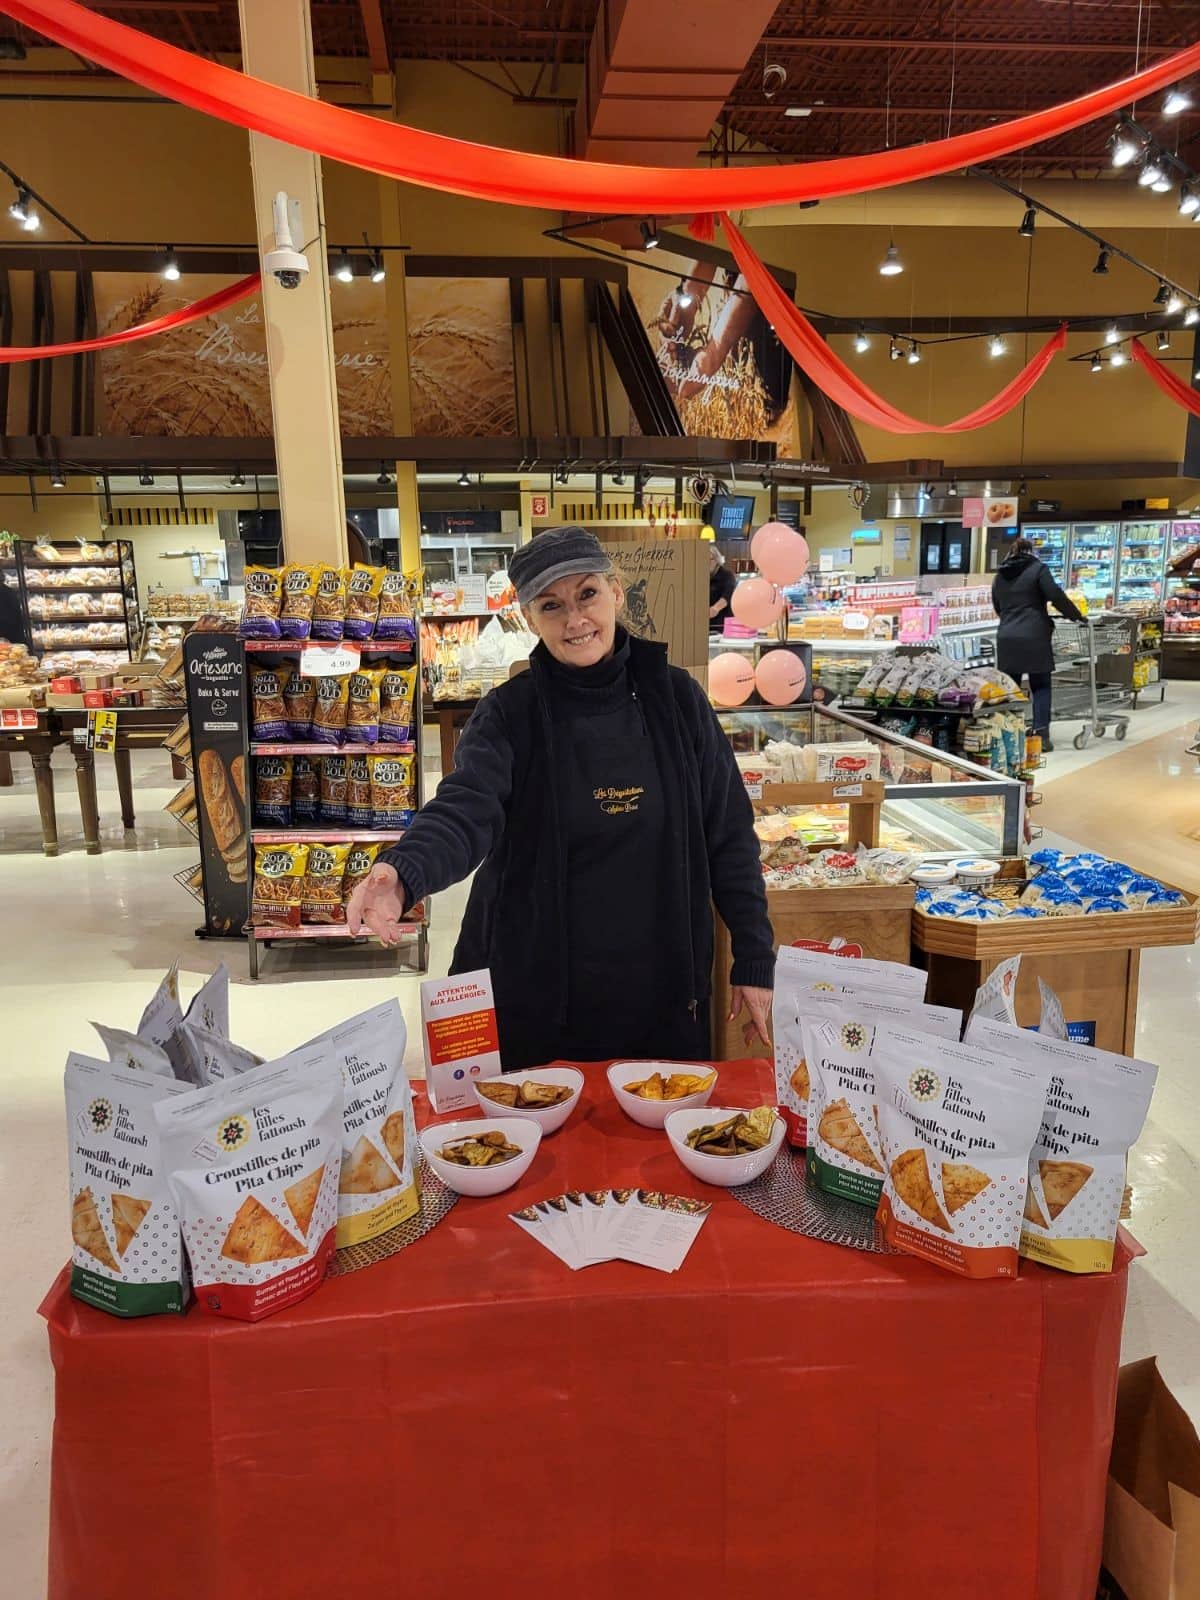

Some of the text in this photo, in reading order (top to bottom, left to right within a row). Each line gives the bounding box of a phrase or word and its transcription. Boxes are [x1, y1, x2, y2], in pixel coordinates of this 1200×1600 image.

[246, 583, 278, 592] GOLD
[287, 580, 310, 591] OLD
[350, 581, 371, 591] OLD
[190, 659, 242, 675] Artesano
[331, 660, 351, 668] 4.99
[197, 688, 212, 696] Bake
[214, 688, 220, 696] &
[319, 687, 342, 698] OLD
[351, 686, 371, 697] OLD
[374, 762, 401, 770] ROLD
[373, 770, 405, 781] GOLD
[262, 861, 293, 872] GOLD
[311, 860, 334, 871] OLD
[436, 984, 478, 997] ATTENTION
[430, 990, 486, 1007] AUX ALLERGIES
[345, 1055, 358, 1065] les
[348, 1061, 370, 1076] filles
[351, 1062, 388, 1086] fattoush
[838, 1076, 861, 1091] Pita
[946, 1075, 963, 1090] les
[1051, 1074, 1065, 1086] es
[944, 1088, 971, 1106] filles
[1046, 1084, 1073, 1101] illes
[118, 1103, 130, 1117] les
[343, 1089, 385, 1118] stilles de
[252, 1106, 270, 1118] les
[344, 1104, 388, 1133] Pita Chip
[941, 1100, 986, 1124] fattoush
[115, 1115, 134, 1132] filles
[255, 1113, 285, 1130] filles
[259, 1117, 306, 1142] fattoush
[1052, 1123, 1100, 1148] de pita
[113, 1127, 148, 1148] fattoush
[914, 1125, 967, 1160] Pita Chips
[950, 1126, 967, 1143] de
[968, 1134, 996, 1151] pita
[118, 1156, 131, 1170] de
[132, 1160, 154, 1177] pita
[205, 1136, 322, 1185] Croustilles de pita
[84, 1161, 131, 1189] Pita Chips
[235, 1162, 304, 1193] Pita Chips
